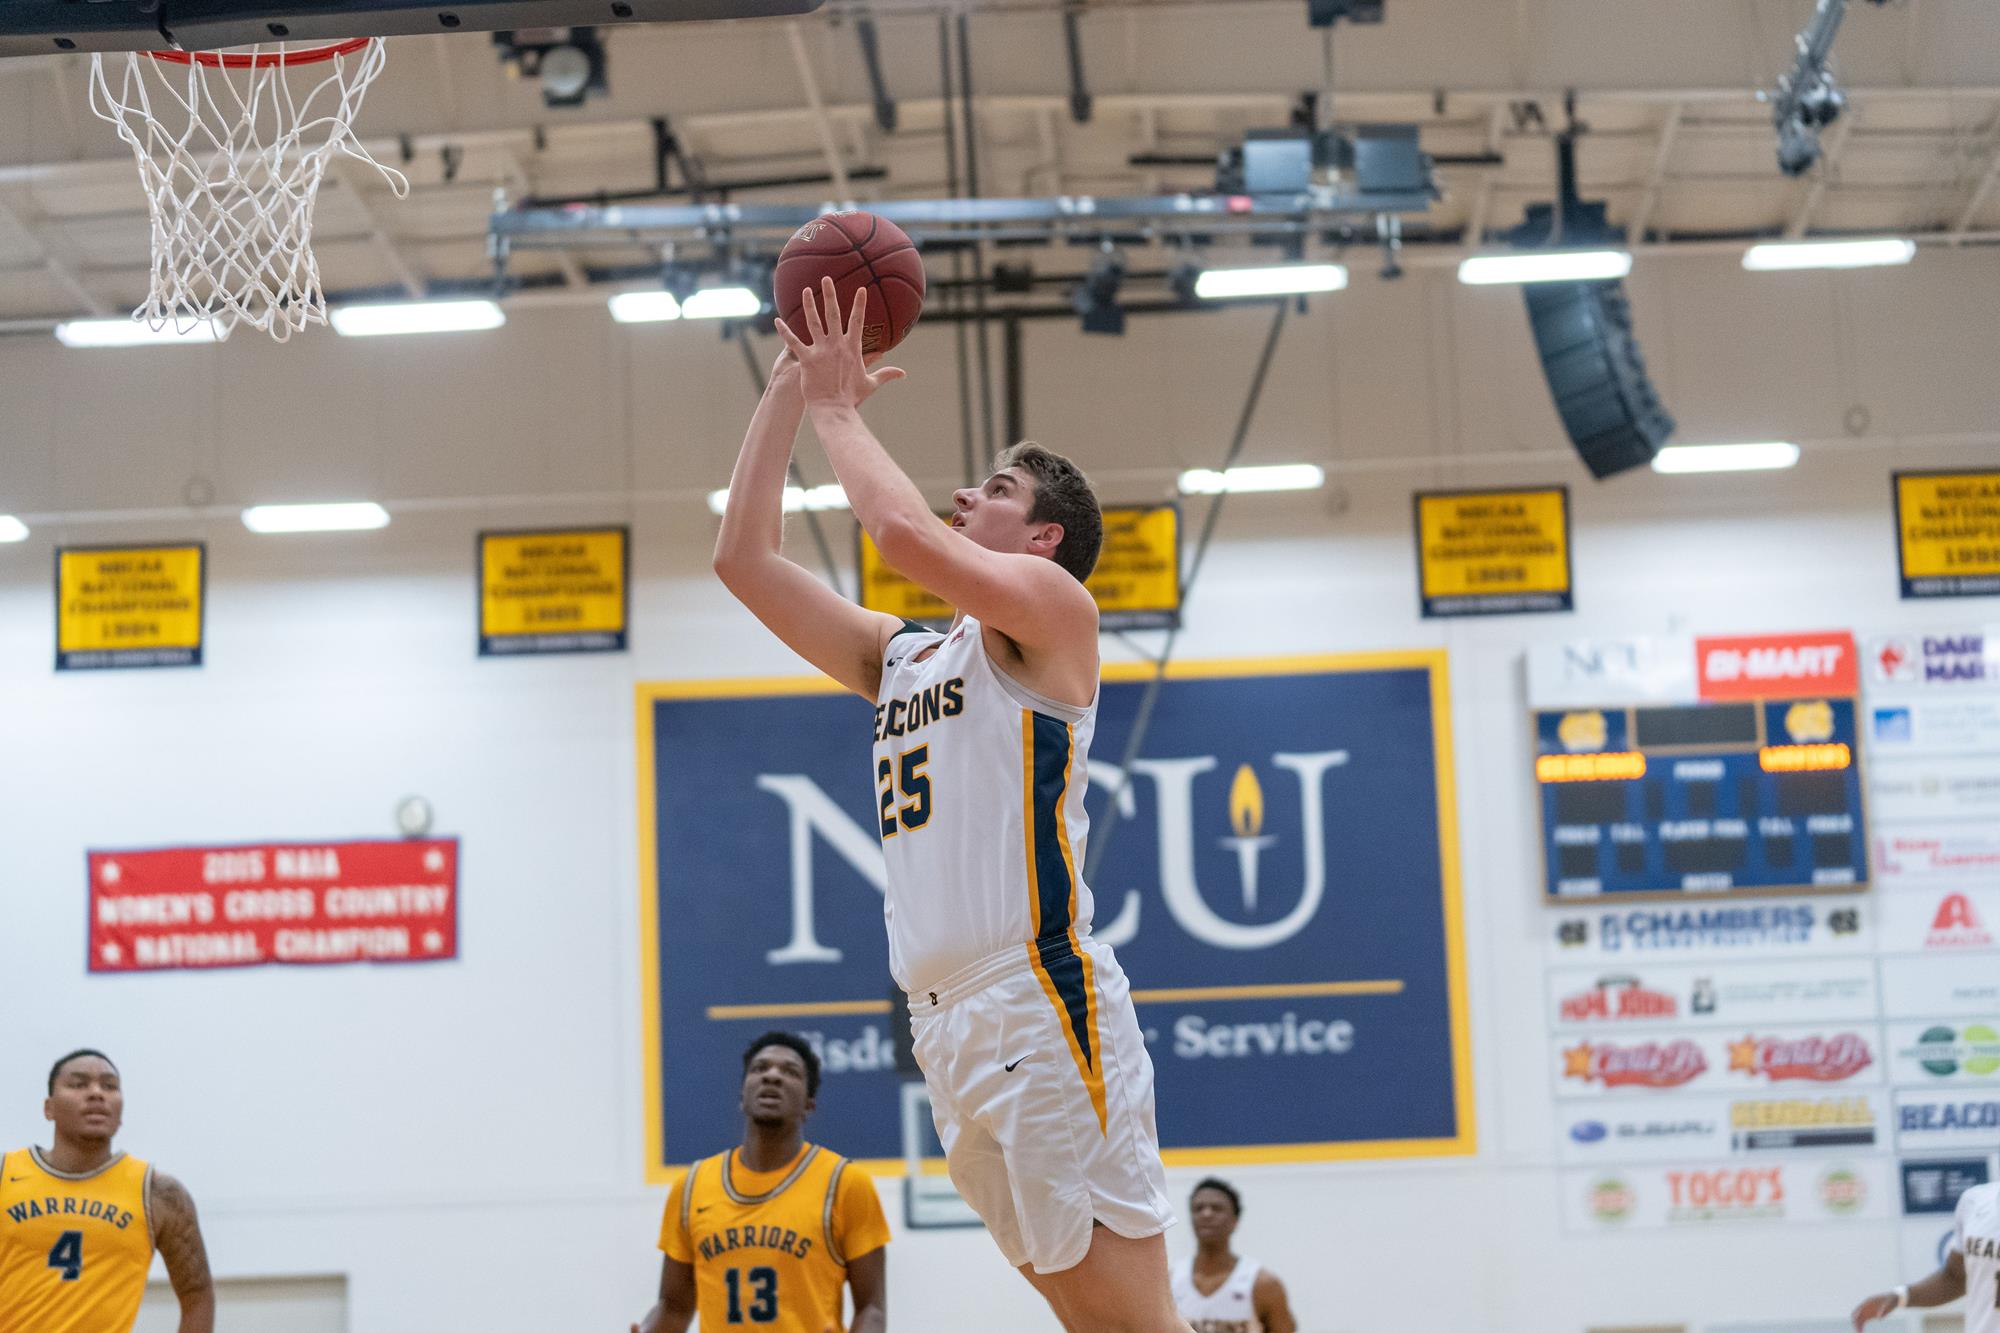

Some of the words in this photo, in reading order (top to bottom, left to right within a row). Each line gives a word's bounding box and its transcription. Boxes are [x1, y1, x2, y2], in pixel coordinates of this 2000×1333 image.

[1705, 643, 1843, 682] BI-MART
[873, 676, 965, 742] EACONS
[878, 741, 933, 841] 25
[203, 850, 266, 883] 2015
[273, 848, 340, 880] NAIA
[98, 892, 215, 925] WOMEN'S
[223, 888, 315, 921] CROSS
[324, 884, 449, 918] COUNTRY
[1626, 905, 1816, 935] CHAMBERS
[134, 930, 259, 964] NATIONAL
[274, 926, 410, 959] CHAMPION
[1173, 1011, 1356, 1059] Service
[1665, 1165, 1786, 1208] TOGO'S
[7, 1196, 135, 1231] WARRIORS
[47, 1230, 83, 1282] 4
[698, 1223, 813, 1262] WARRIORS
[725, 1265, 779, 1325] 13
